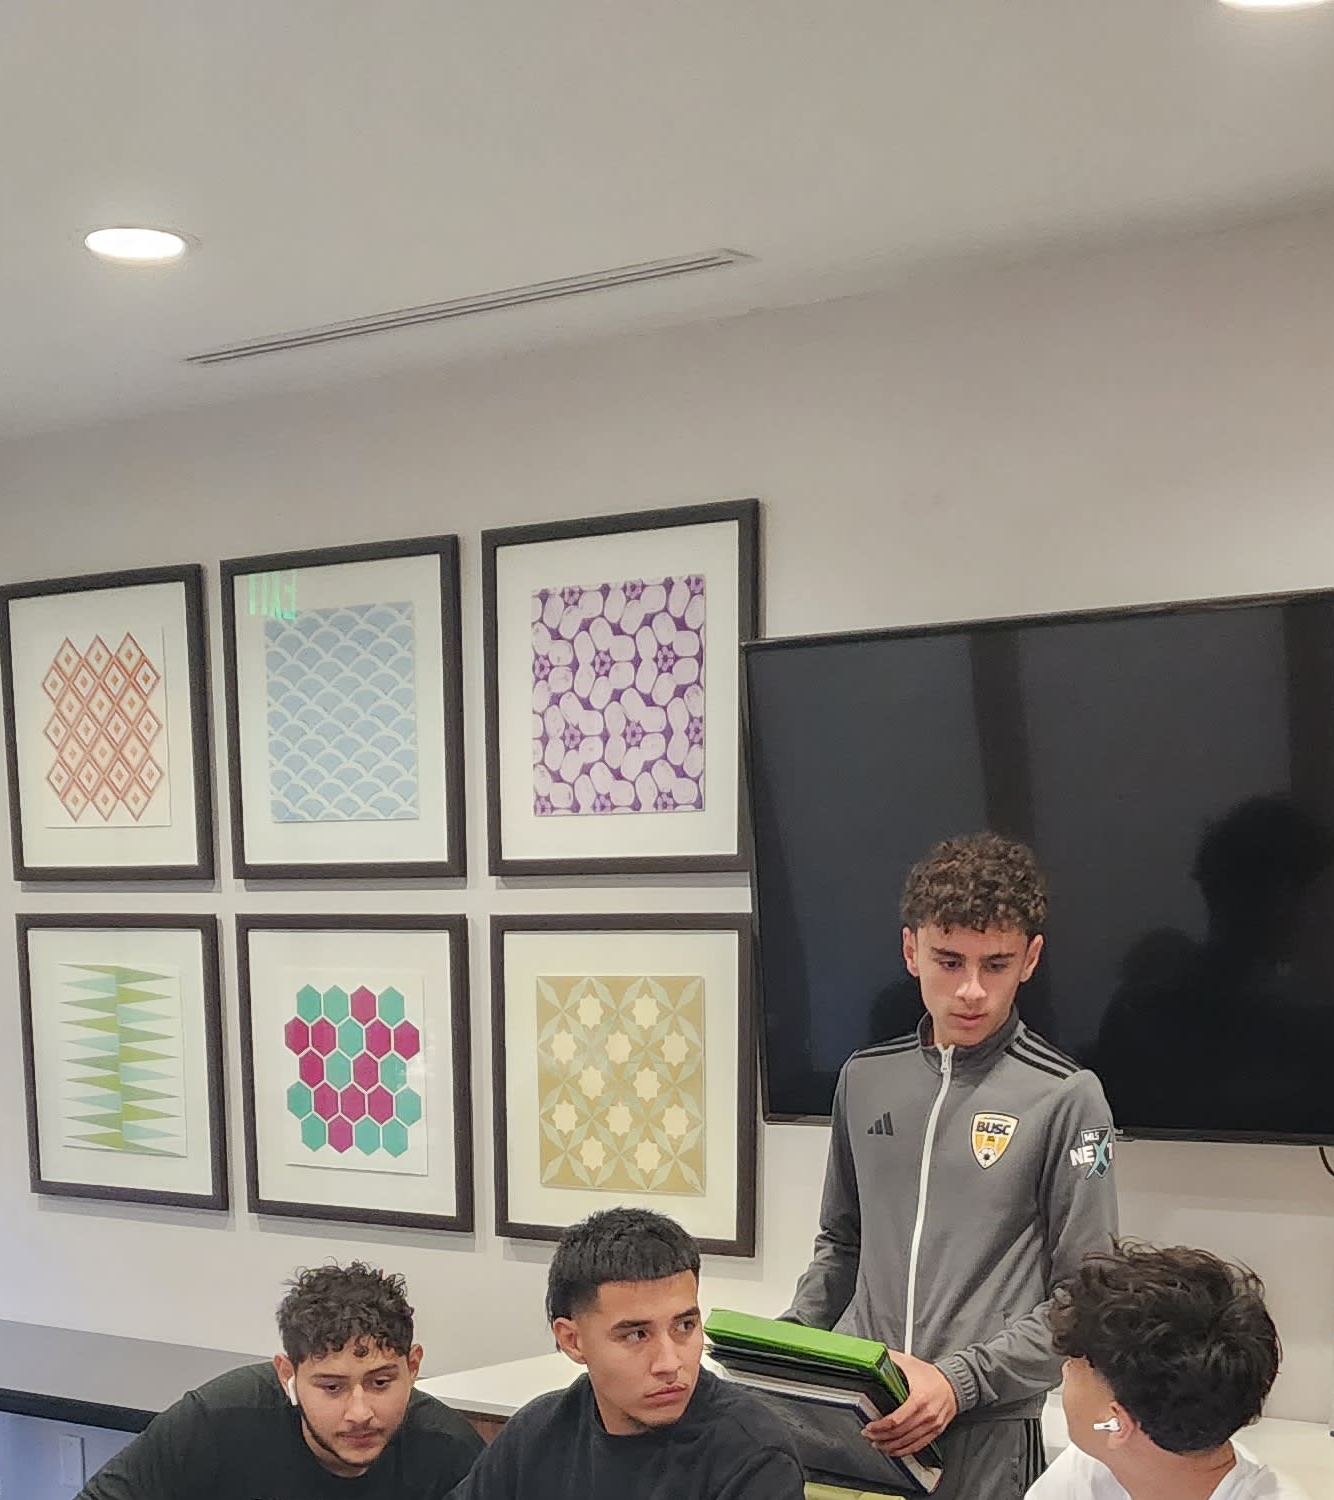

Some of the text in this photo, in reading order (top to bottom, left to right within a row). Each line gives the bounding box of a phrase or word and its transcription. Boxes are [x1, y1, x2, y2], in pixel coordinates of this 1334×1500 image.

[977, 1121, 1011, 1135] BUSC
[1083, 1131, 1100, 1142] MLS
[1069, 1140, 1113, 1177] NEXT
